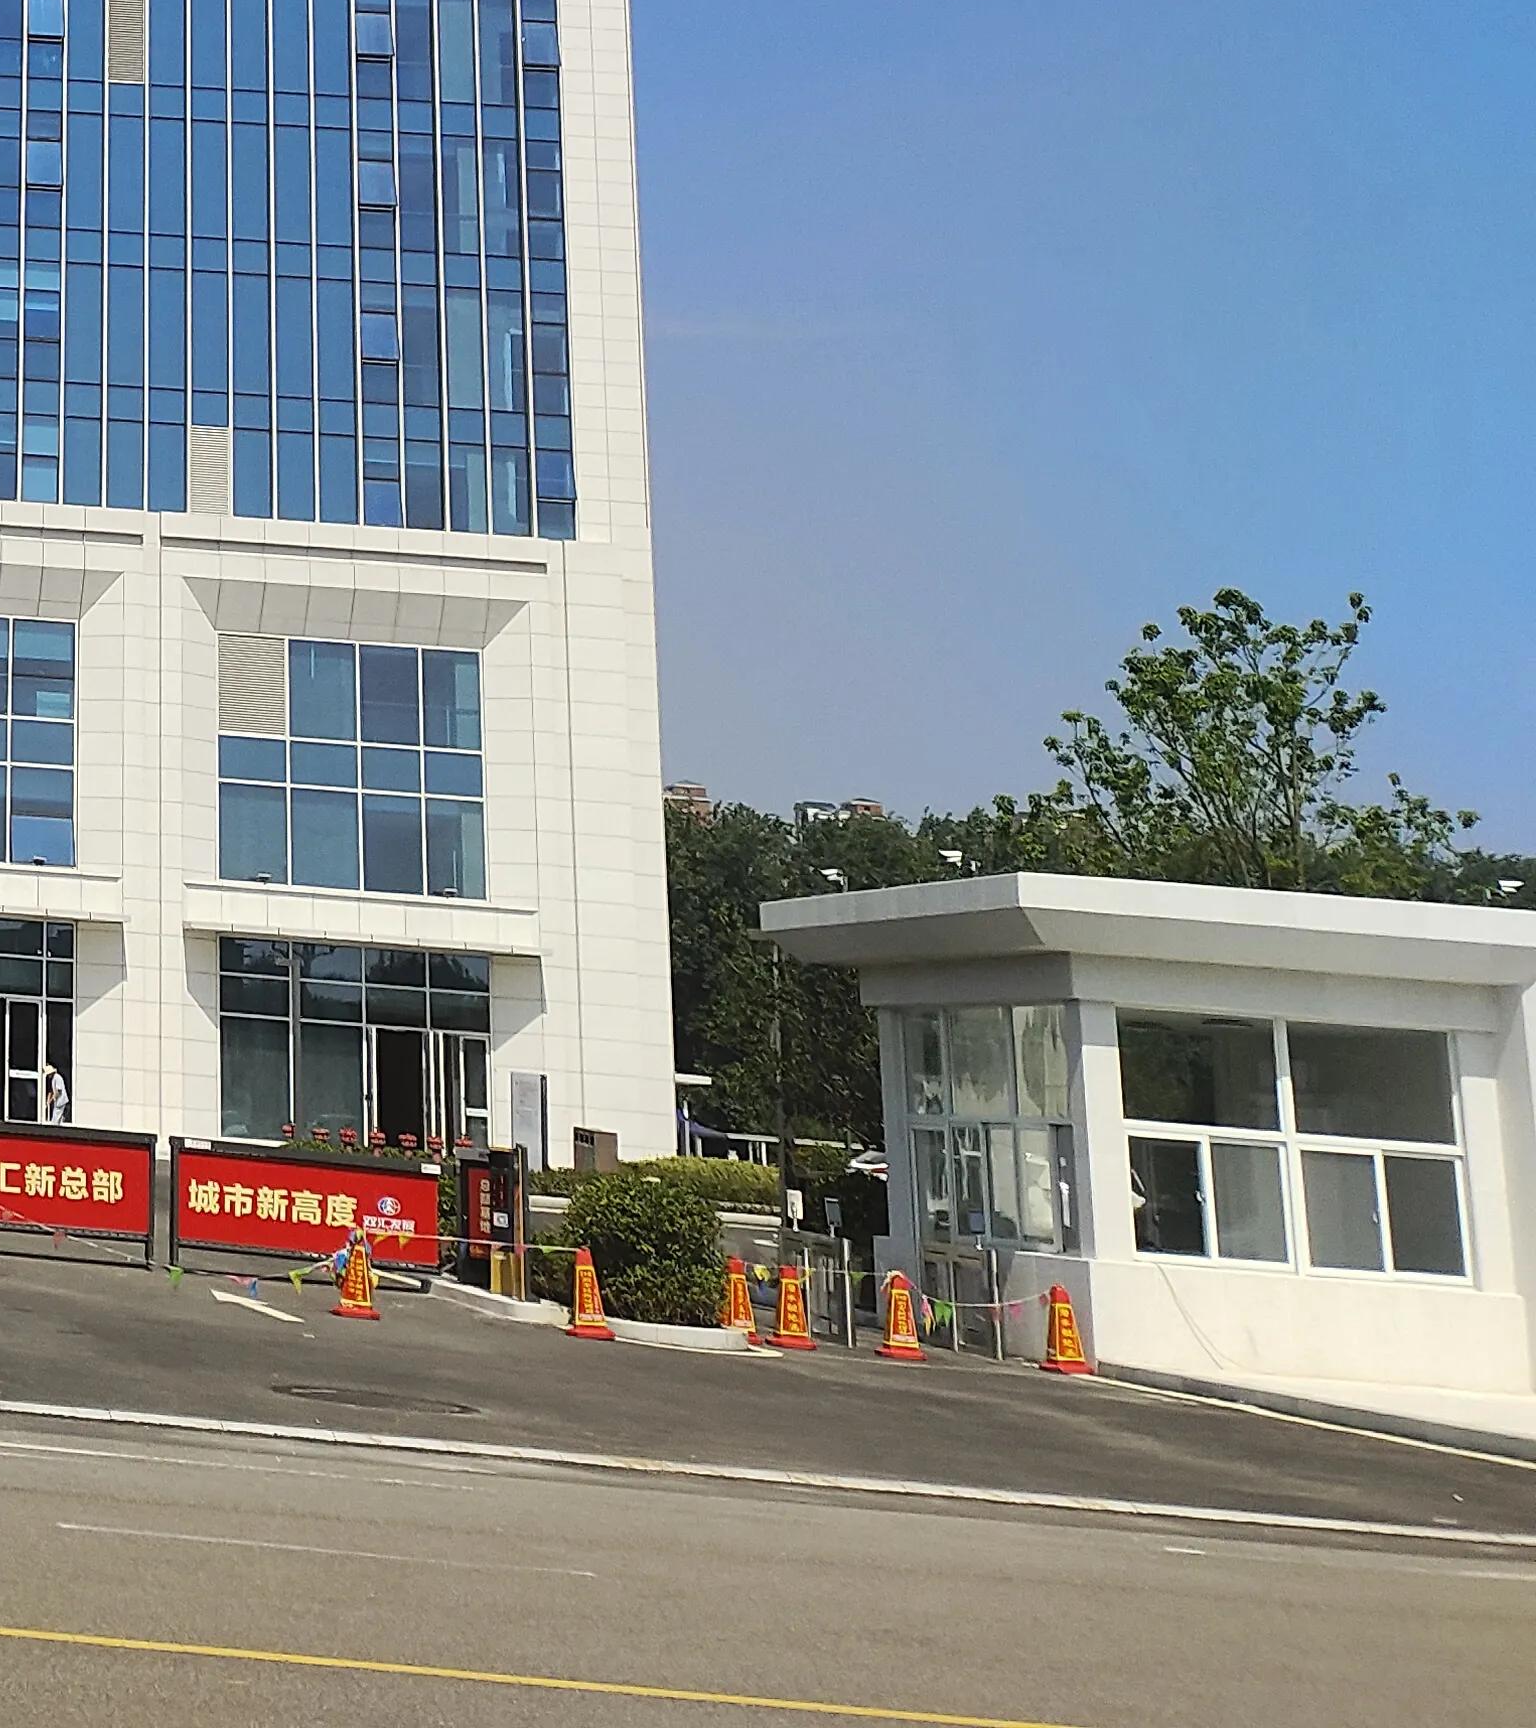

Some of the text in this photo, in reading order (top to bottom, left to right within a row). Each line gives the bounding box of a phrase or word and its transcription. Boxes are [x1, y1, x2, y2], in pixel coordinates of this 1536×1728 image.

[188, 1178, 358, 1228] 城市新高度
